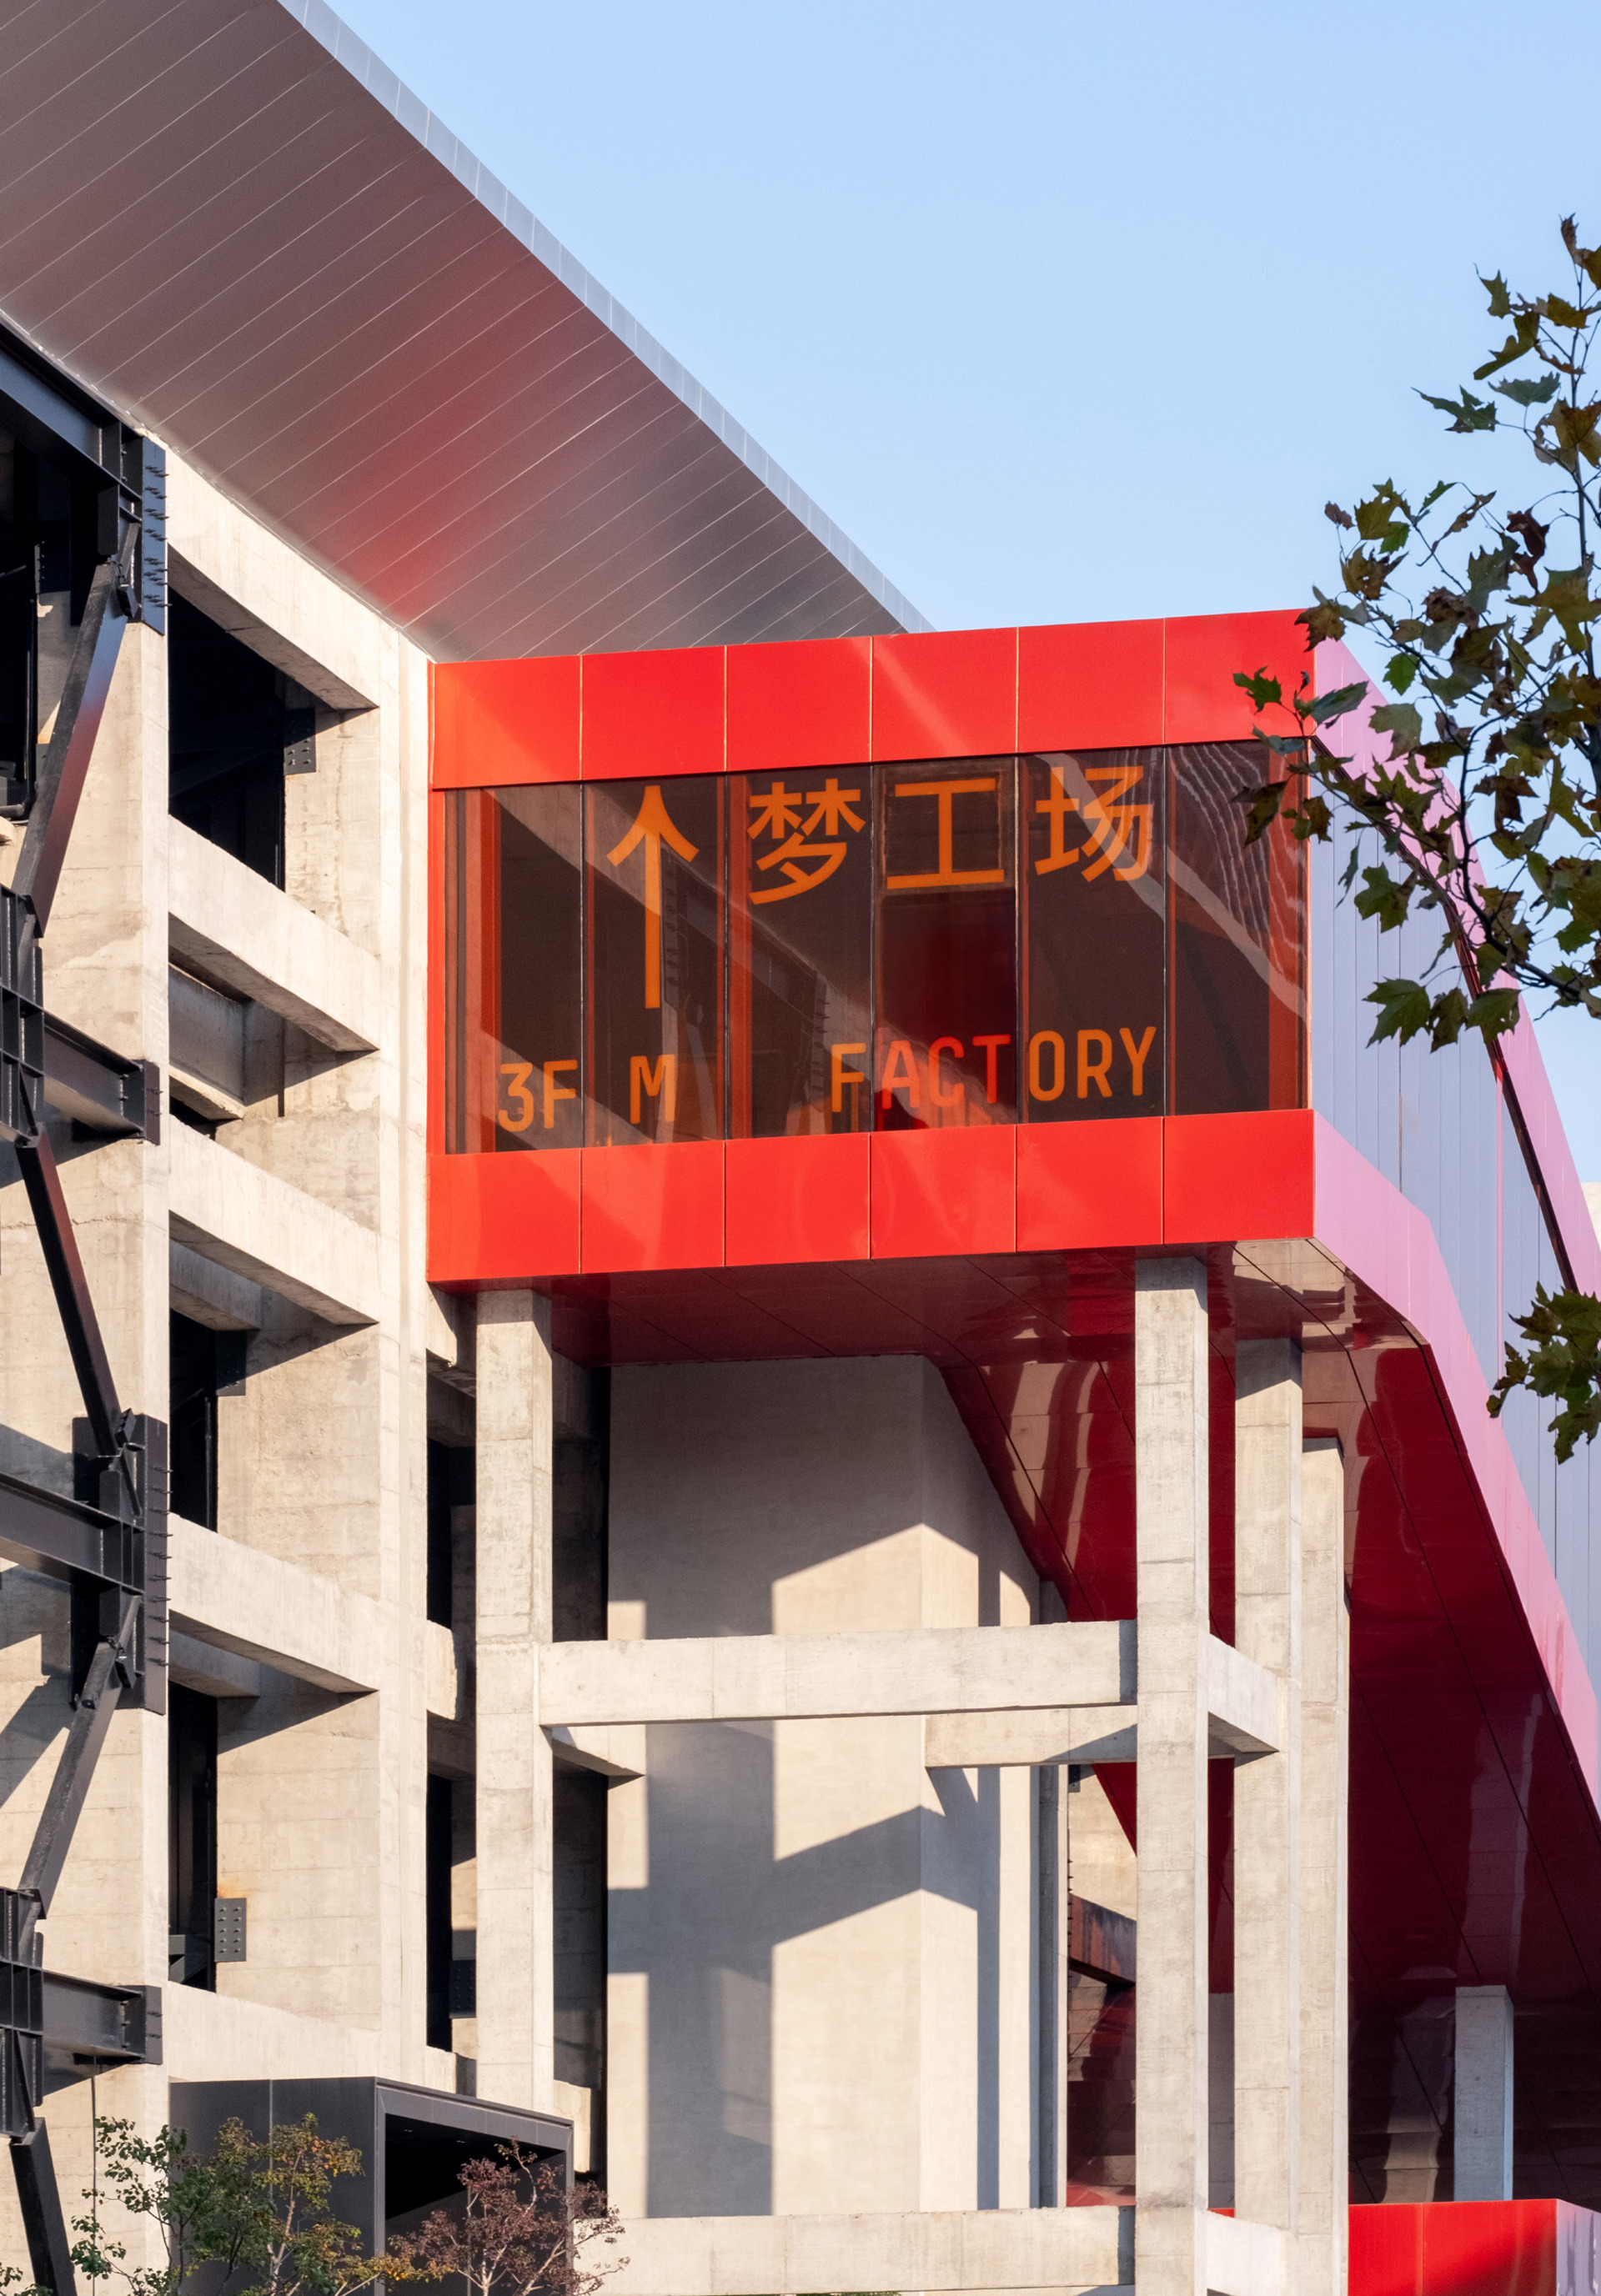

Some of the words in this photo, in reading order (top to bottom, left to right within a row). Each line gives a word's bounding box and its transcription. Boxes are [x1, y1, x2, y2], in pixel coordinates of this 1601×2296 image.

[746, 765, 1153, 905] 梦工场
[498, 1059, 578, 1132] 3F
[630, 1054, 675, 1125] M
[831, 1026, 1157, 1113] FACTORY
